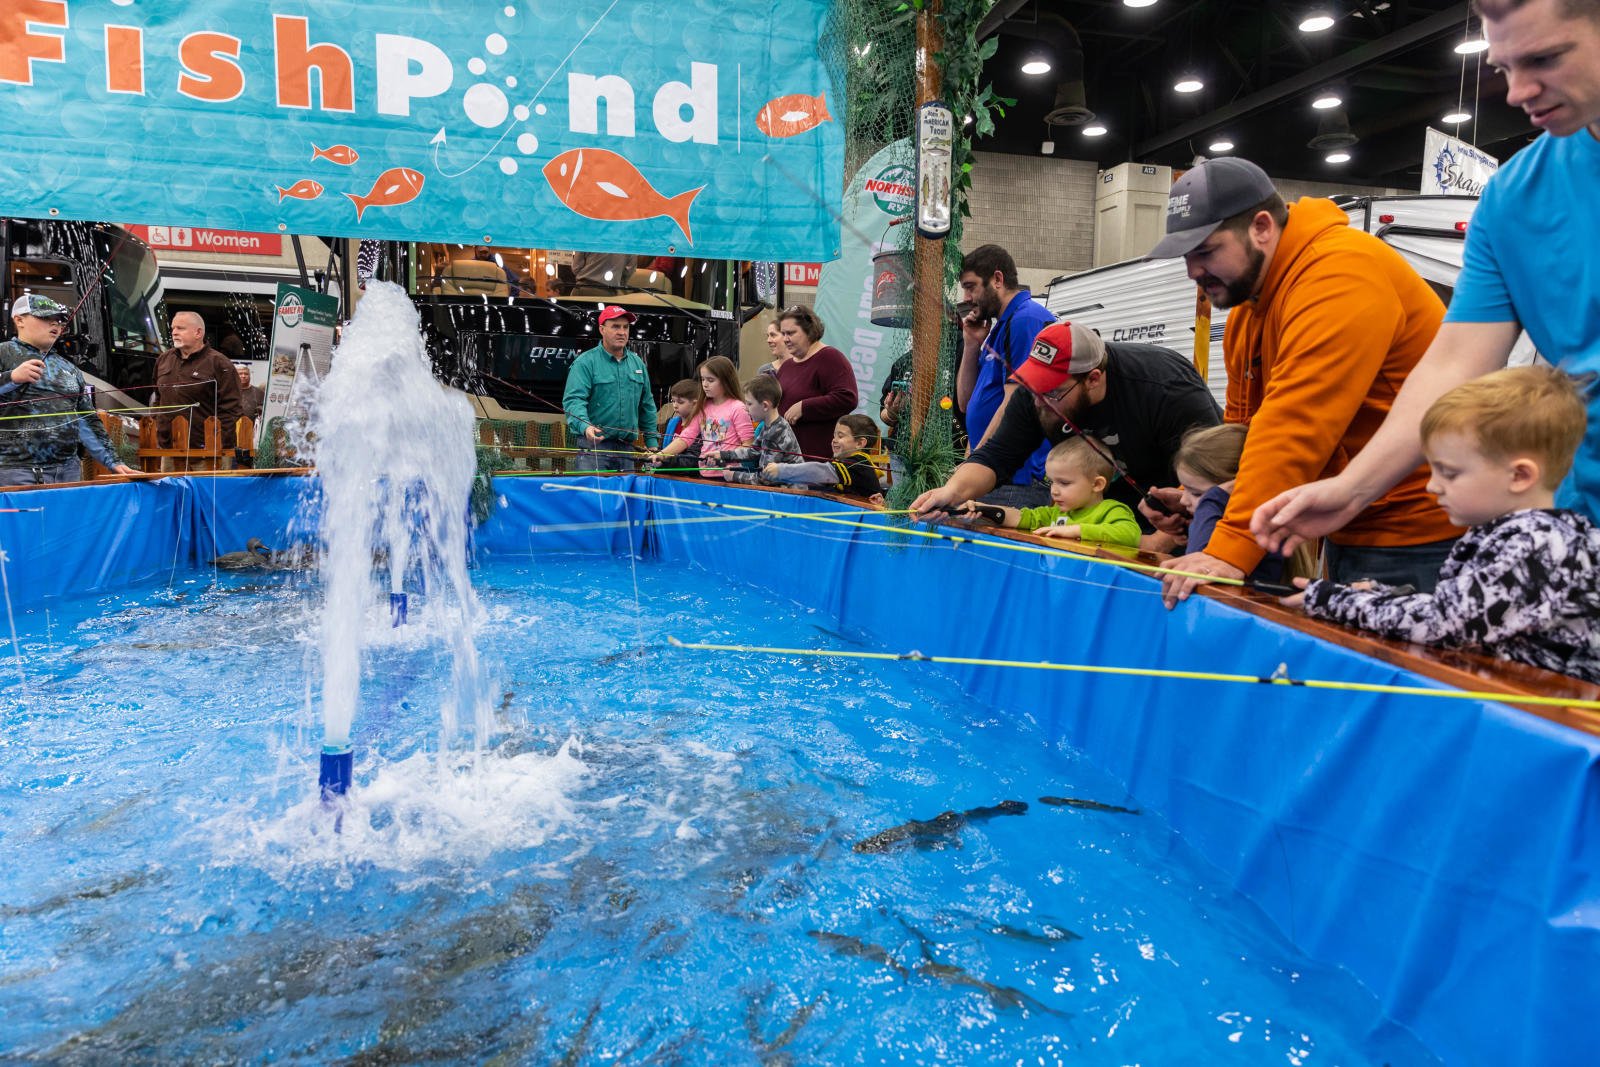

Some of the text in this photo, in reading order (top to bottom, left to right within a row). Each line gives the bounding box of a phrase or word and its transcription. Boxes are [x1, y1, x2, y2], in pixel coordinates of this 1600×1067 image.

[887, 202, 905, 212] RV
[196, 230, 260, 248] Women
[1113, 323, 1165, 342] CLIPPER
[529, 346, 582, 359] OPEN
